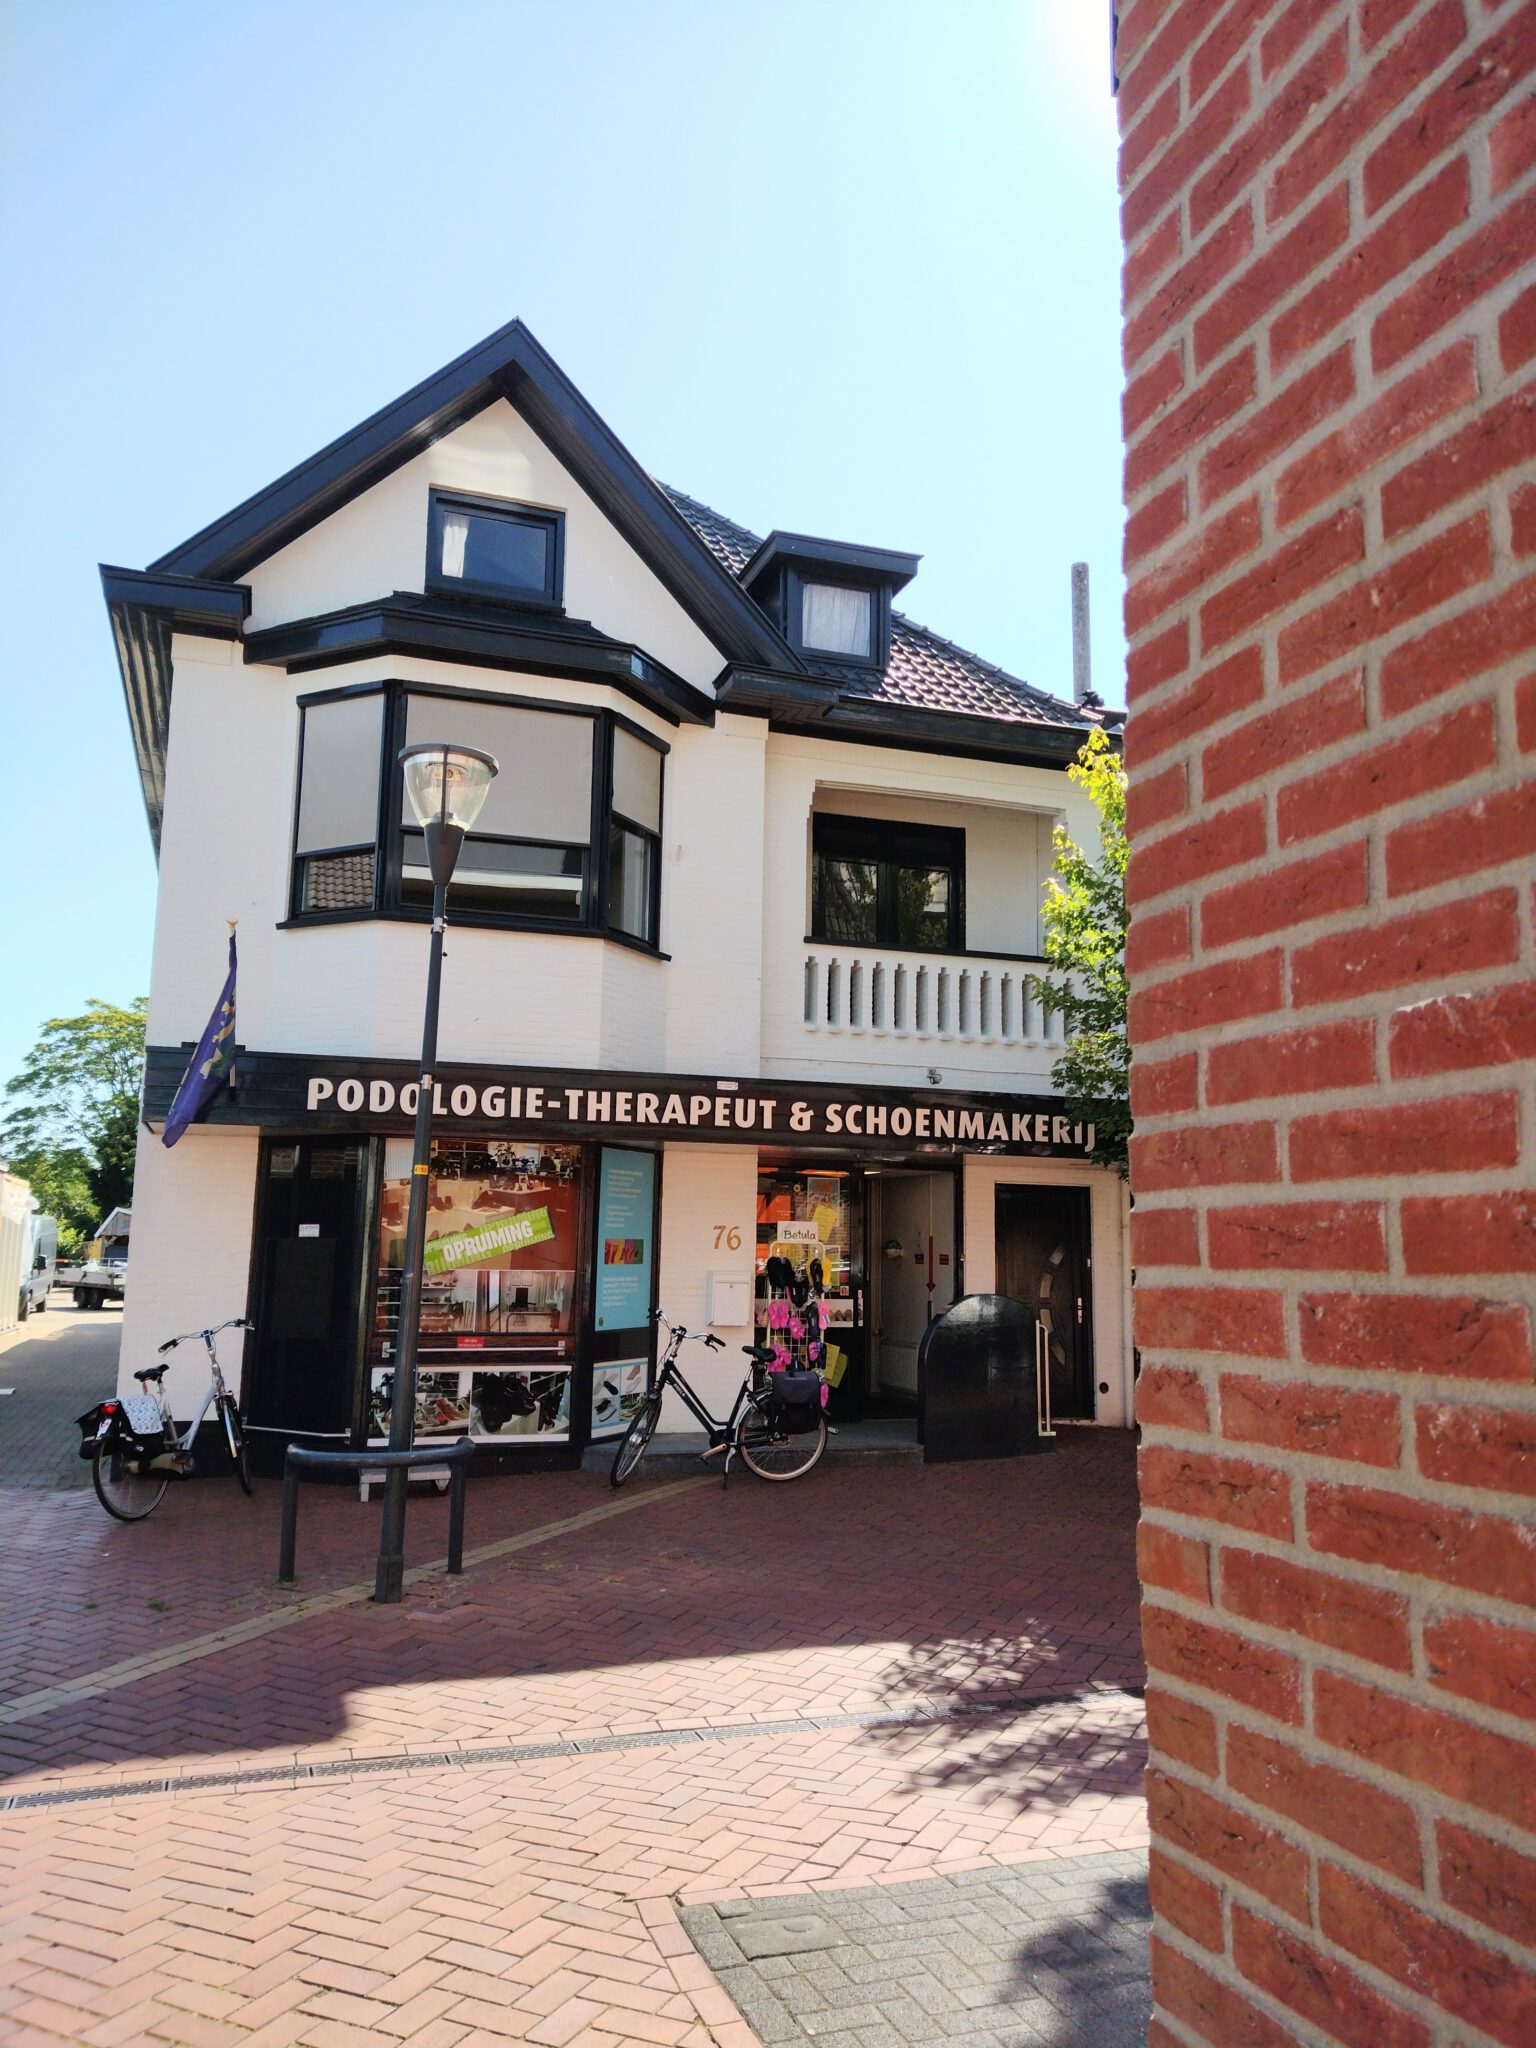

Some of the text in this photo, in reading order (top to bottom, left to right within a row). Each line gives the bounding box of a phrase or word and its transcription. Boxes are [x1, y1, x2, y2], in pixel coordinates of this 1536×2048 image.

[306, 1077, 1095, 1153] PODOLOGIE-THERAPEUT & SCHOENMAKERIJ
[442, 1220, 534, 1263] OPRUIMING
[712, 1225, 742, 1251] 76
[783, 1229, 817, 1241] Betula
